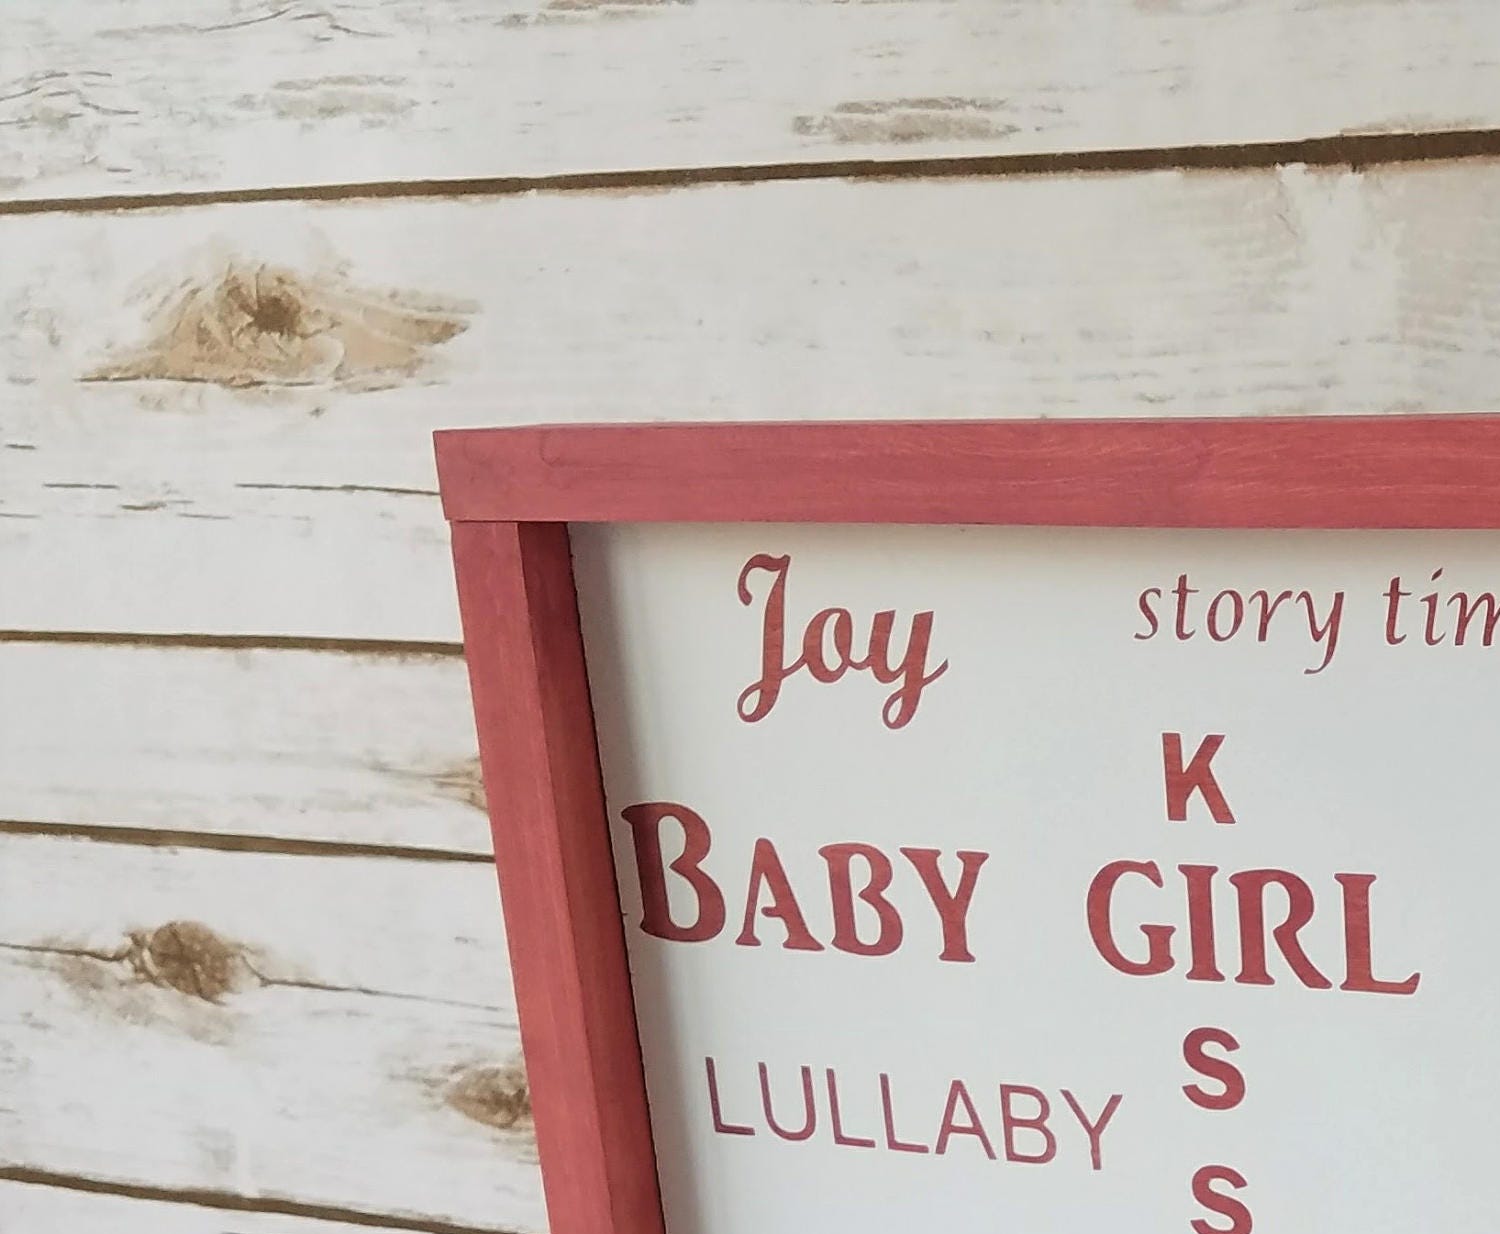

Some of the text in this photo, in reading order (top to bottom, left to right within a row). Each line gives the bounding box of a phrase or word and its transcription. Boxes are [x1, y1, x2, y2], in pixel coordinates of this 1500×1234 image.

[737, 553, 949, 729] Joy
[1134, 570, 1345, 675] story
[620, 801, 1421, 995] BABY GIRL
[704, 1055, 1123, 1171] LULLABY
